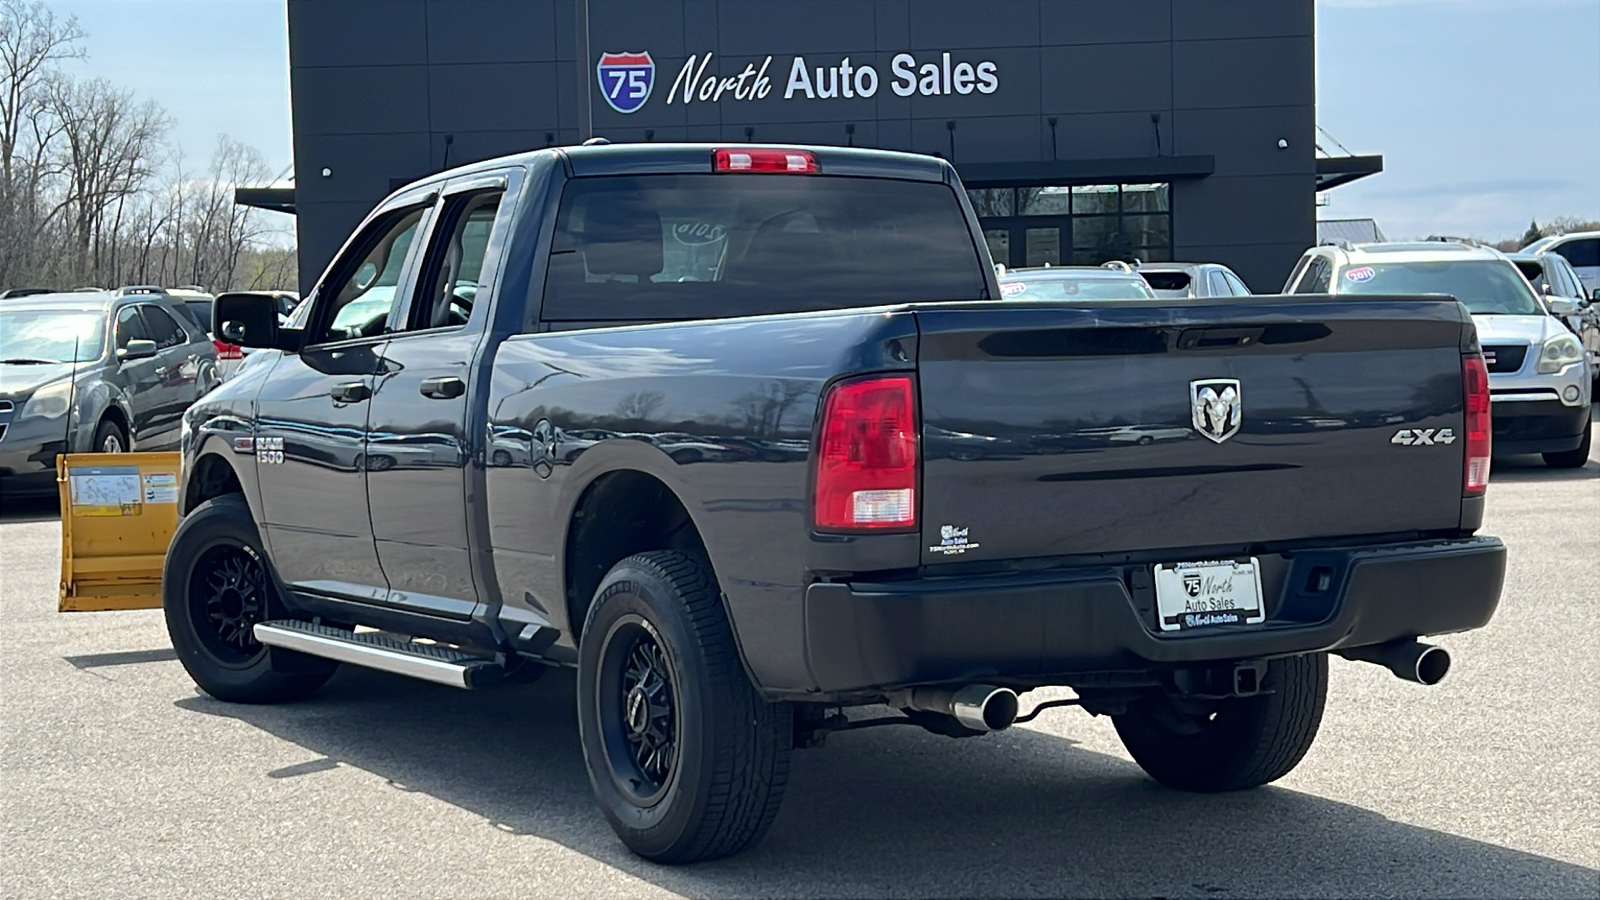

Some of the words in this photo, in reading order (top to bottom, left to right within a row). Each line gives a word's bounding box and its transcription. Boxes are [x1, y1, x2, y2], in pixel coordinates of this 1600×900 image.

[608, 70, 647, 99] 75
[666, 52, 772, 105] North
[784, 56, 879, 99] Auto
[891, 52, 999, 97] Sales
[1350, 269, 1373, 280] 2011
[1391, 428, 1457, 446] 4X4
[1185, 580, 1200, 593] 75
[1202, 576, 1233, 595] North
[1185, 599, 1208, 613] Auto
[1209, 597, 1235, 610] Sales
